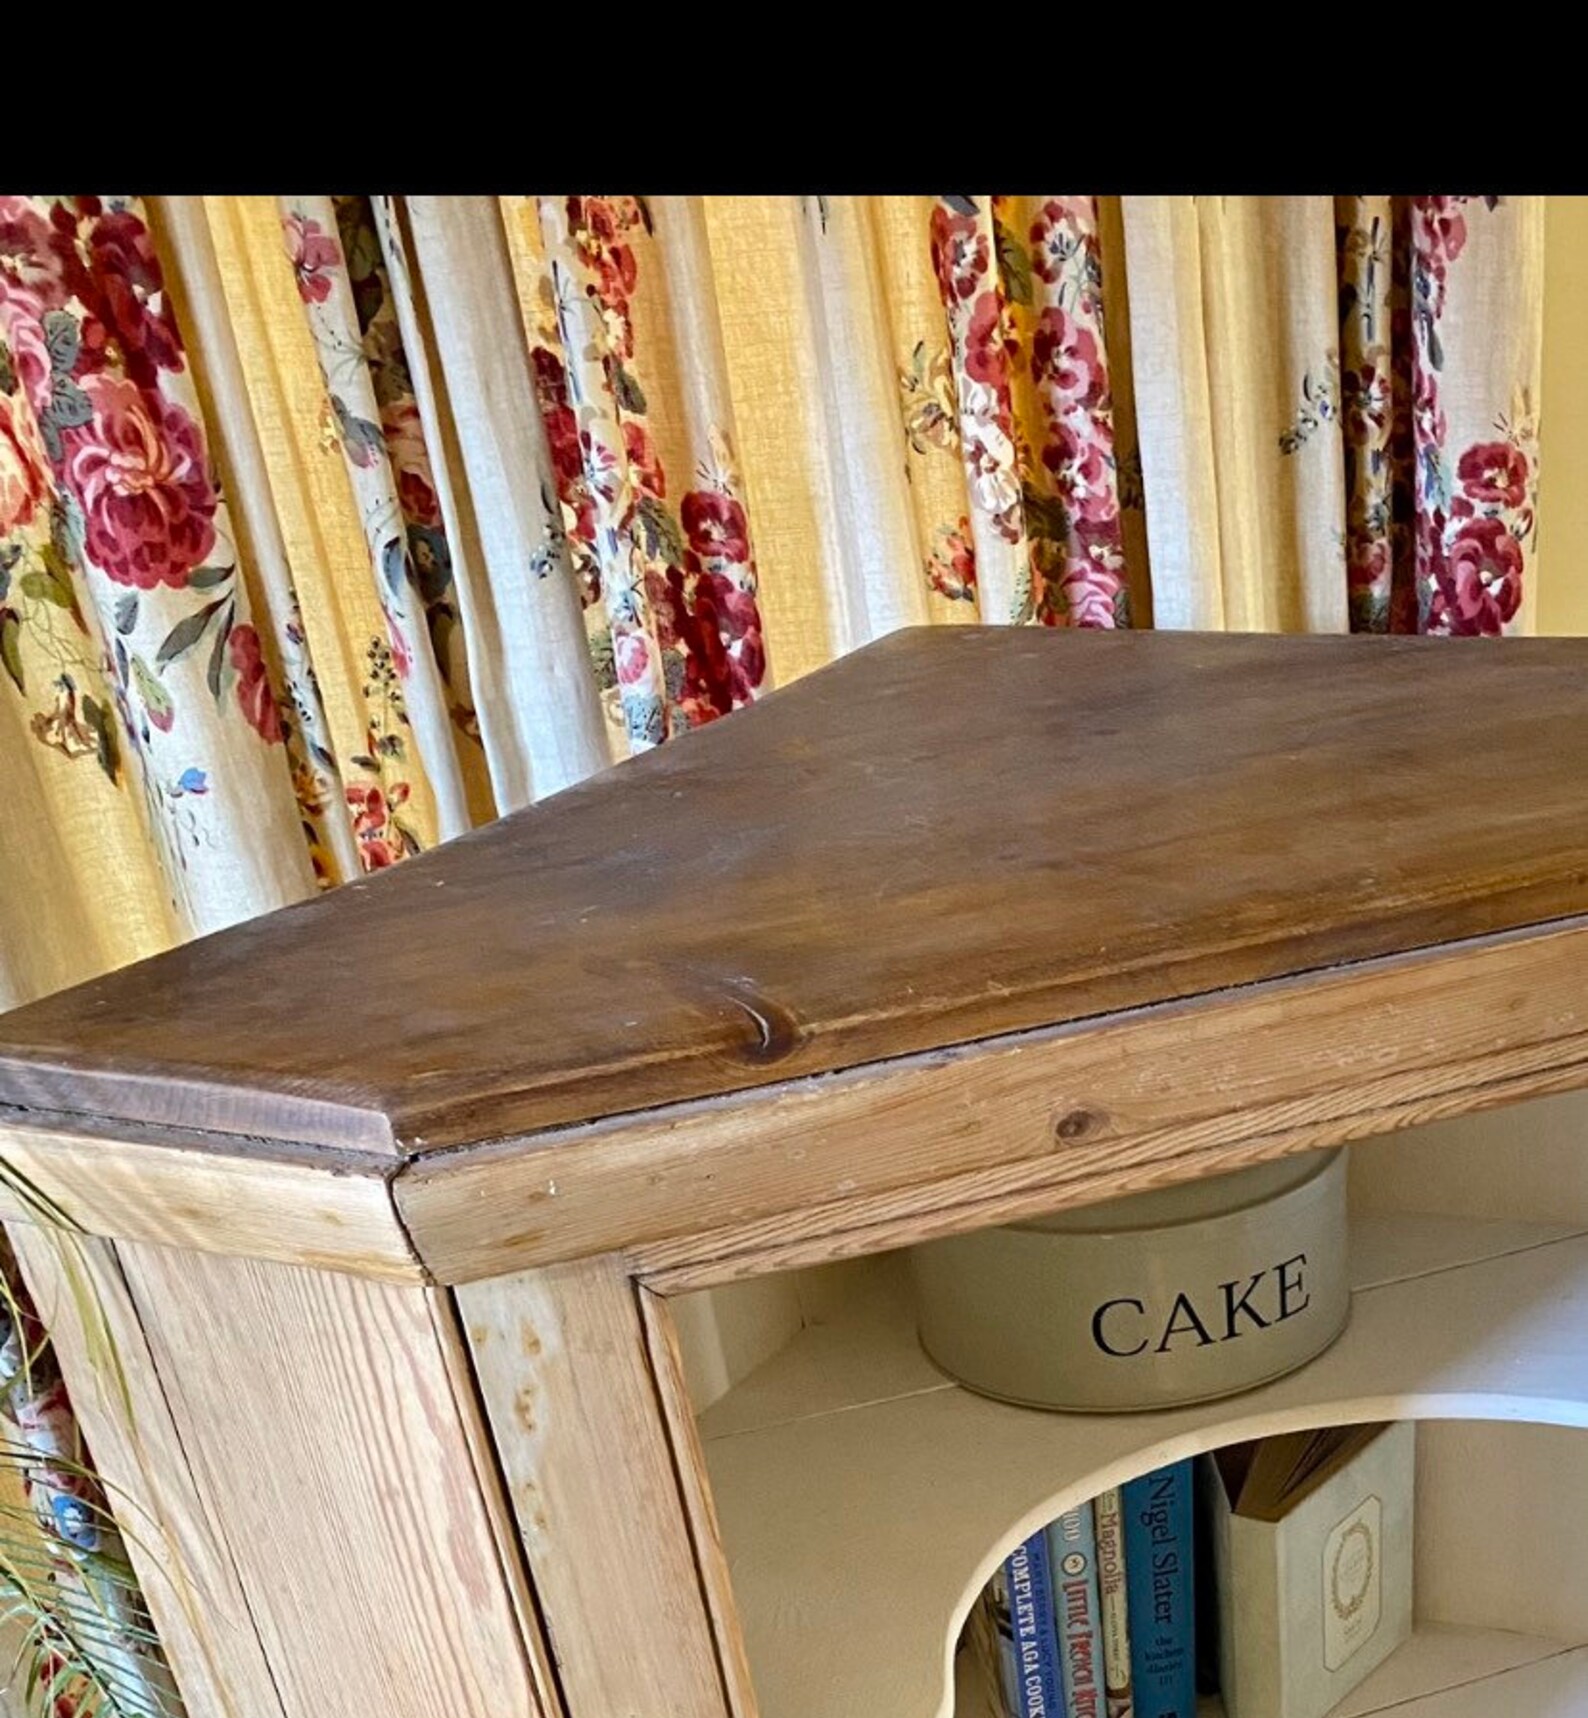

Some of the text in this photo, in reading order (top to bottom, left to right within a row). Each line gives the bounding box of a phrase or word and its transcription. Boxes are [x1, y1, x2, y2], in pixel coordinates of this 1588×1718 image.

[1091, 1253, 1311, 1357] CAKE
[1012, 1545, 1036, 1637] COMPLETE
[1099, 1511, 1121, 1595] Magnolia
[1140, 1475, 1179, 1624] Nigel Slater
[1021, 1641, 1040, 1675] AGA
